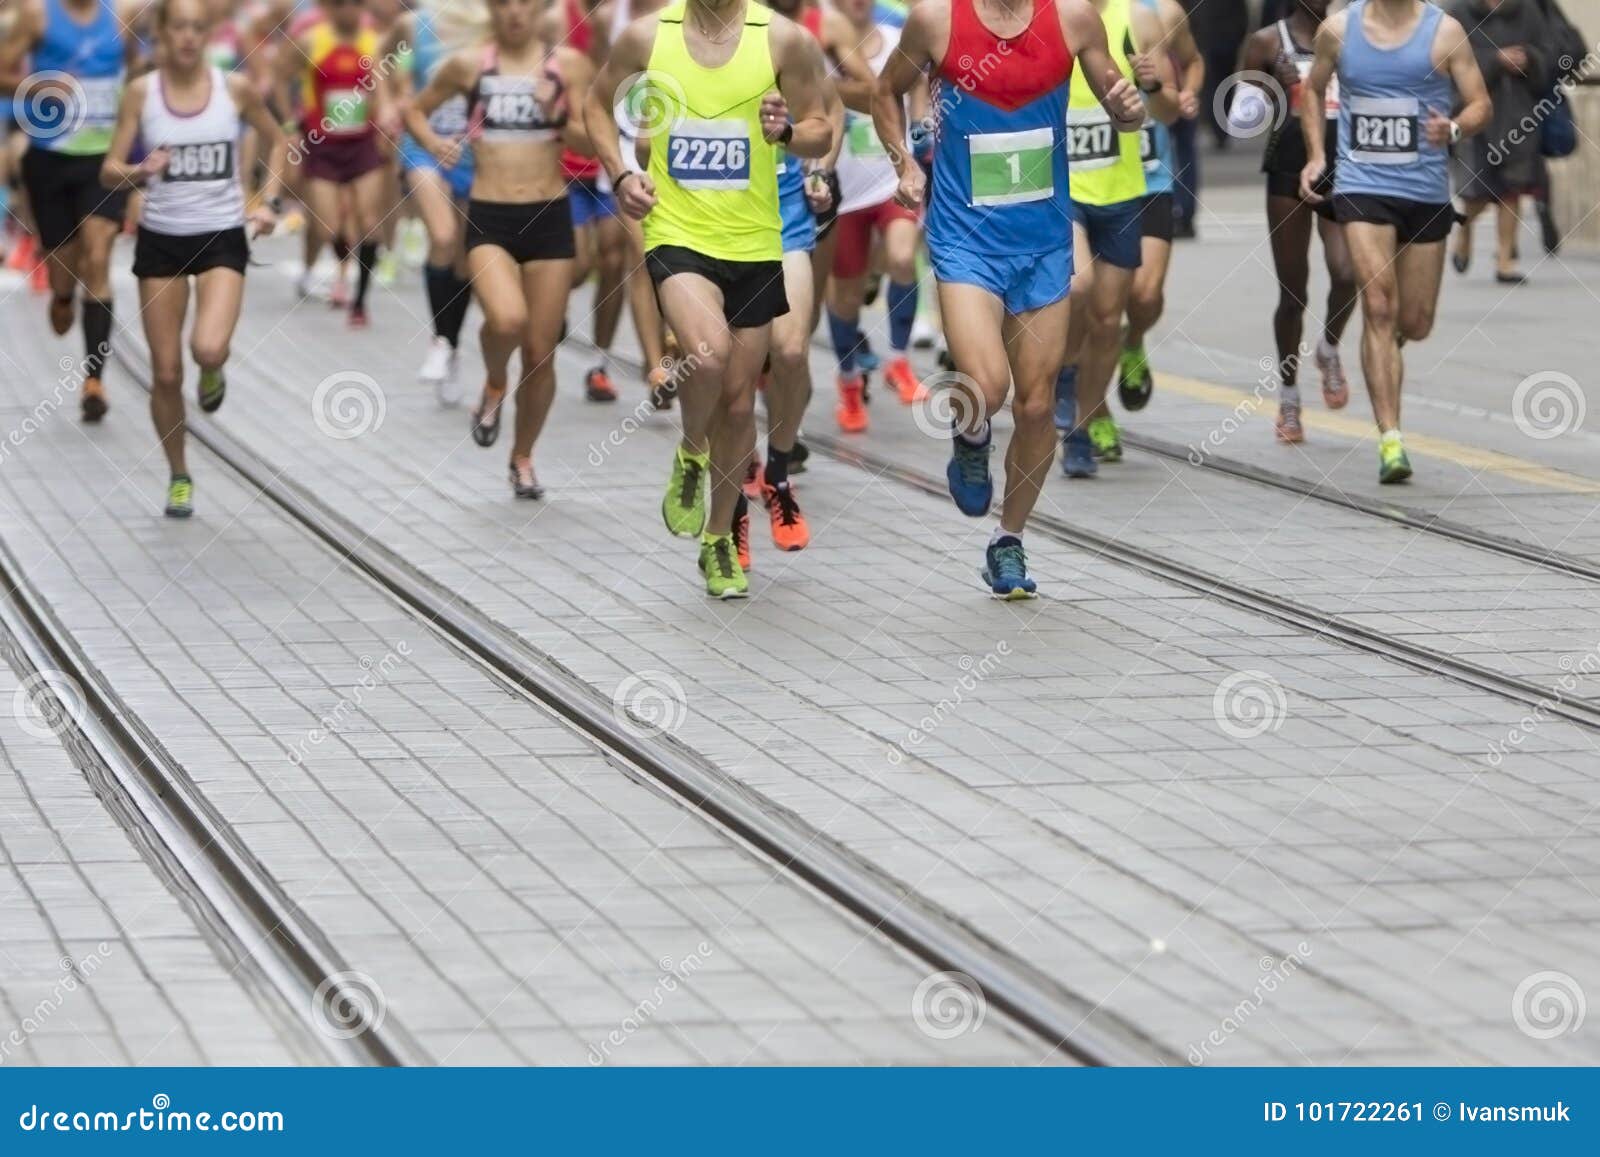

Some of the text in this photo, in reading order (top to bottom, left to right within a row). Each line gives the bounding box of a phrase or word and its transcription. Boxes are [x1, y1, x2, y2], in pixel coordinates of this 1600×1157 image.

[1357, 116, 1411, 147] 8216
[671, 138, 746, 170] 2226
[1006, 152, 1020, 184] 1
